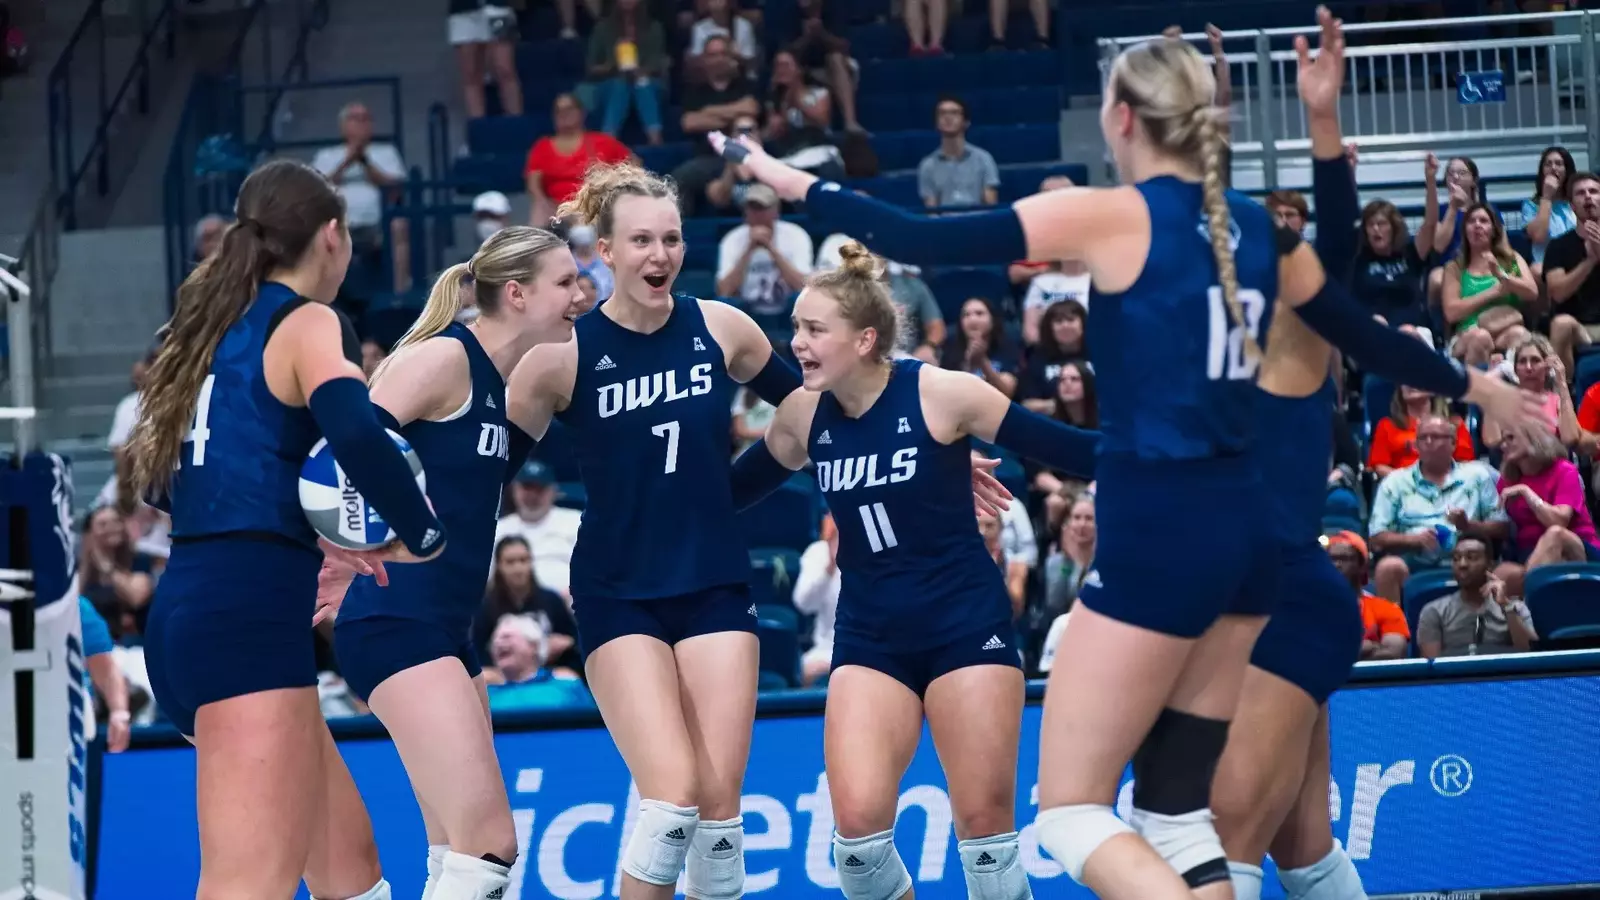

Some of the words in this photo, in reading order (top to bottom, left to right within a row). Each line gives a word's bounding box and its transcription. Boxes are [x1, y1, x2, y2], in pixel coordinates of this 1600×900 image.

[595, 362, 617, 371] adidas
[597, 363, 712, 419] OWLS
[173, 374, 216, 470] 4
[477, 422, 510, 461] OW
[651, 420, 680, 474] 7
[816, 446, 918, 493] OWLS
[342, 476, 363, 531] molte
[858, 502, 898, 553] 11
